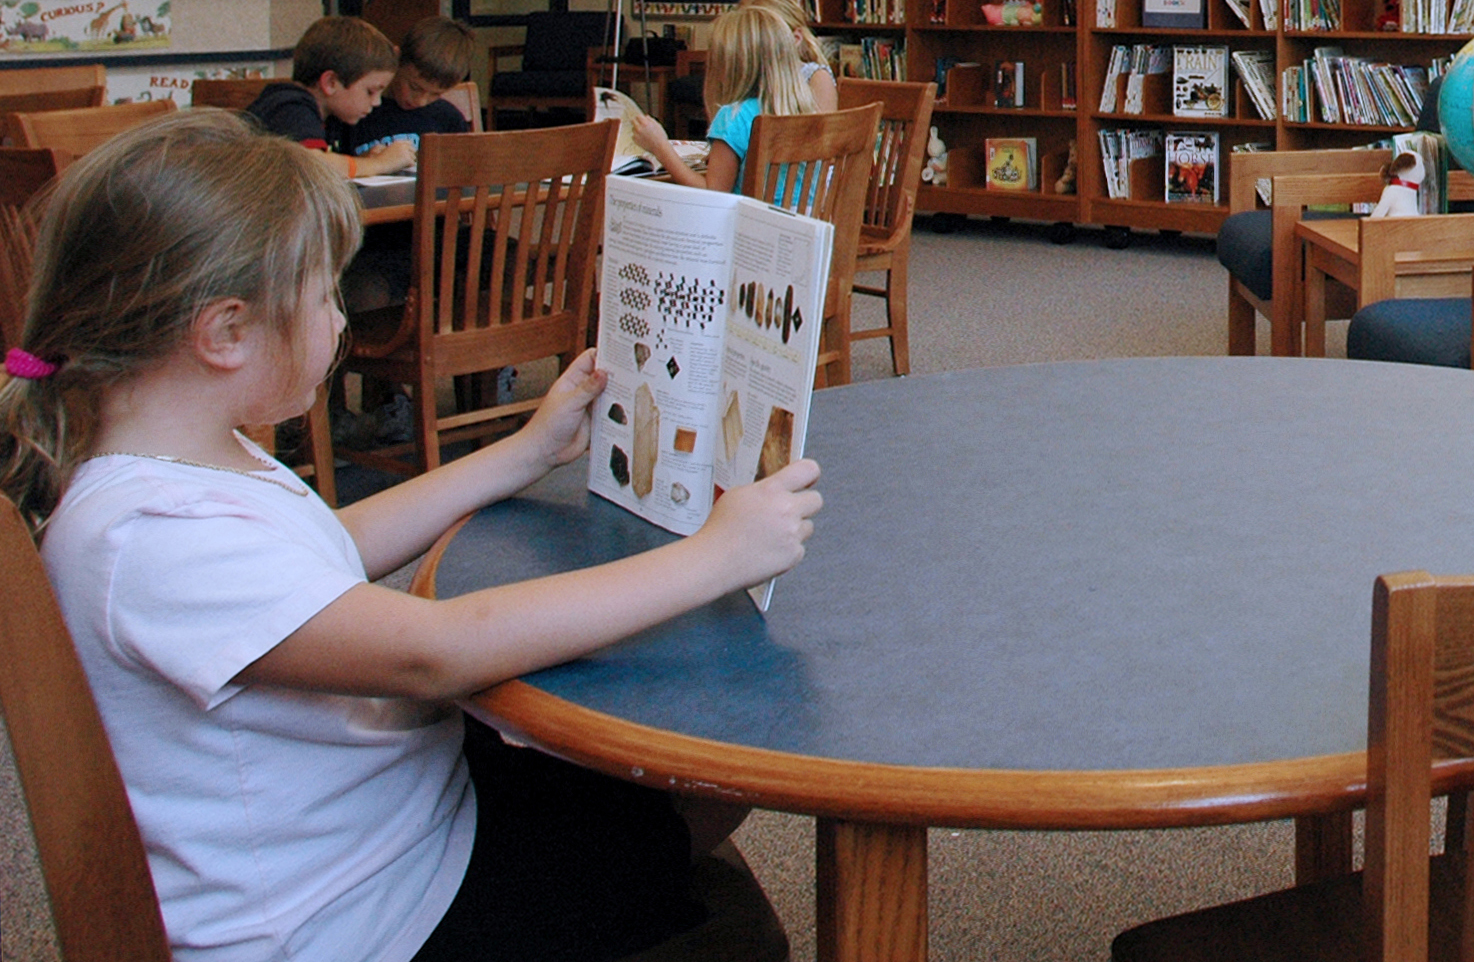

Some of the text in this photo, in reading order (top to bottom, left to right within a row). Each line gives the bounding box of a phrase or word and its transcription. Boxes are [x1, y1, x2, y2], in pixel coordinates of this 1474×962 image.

[40, 2, 105, 23] CURIOUS?
[1176, 54, 1218, 70] TRAIN
[150, 76, 189, 89] READ
